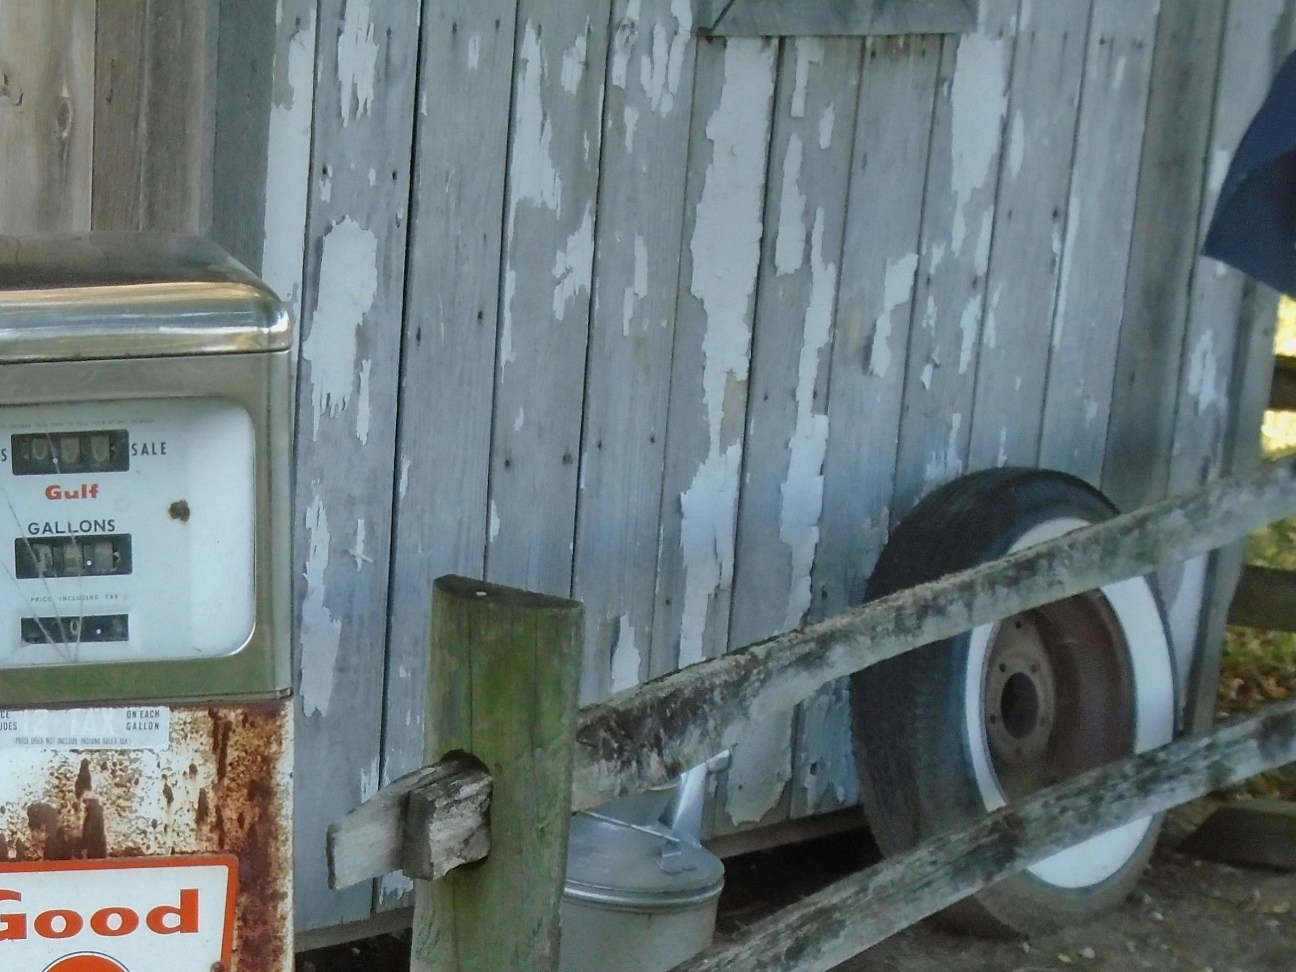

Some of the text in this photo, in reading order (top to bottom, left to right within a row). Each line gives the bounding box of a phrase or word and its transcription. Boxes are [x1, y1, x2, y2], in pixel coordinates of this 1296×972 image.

[131, 441, 168, 456] SALE
[45, 484, 100, 500] Gulf
[28, 519, 116, 535] GALLONS
[126, 709, 160, 719] ON EACH
[125, 721, 160, 731] GALLON
